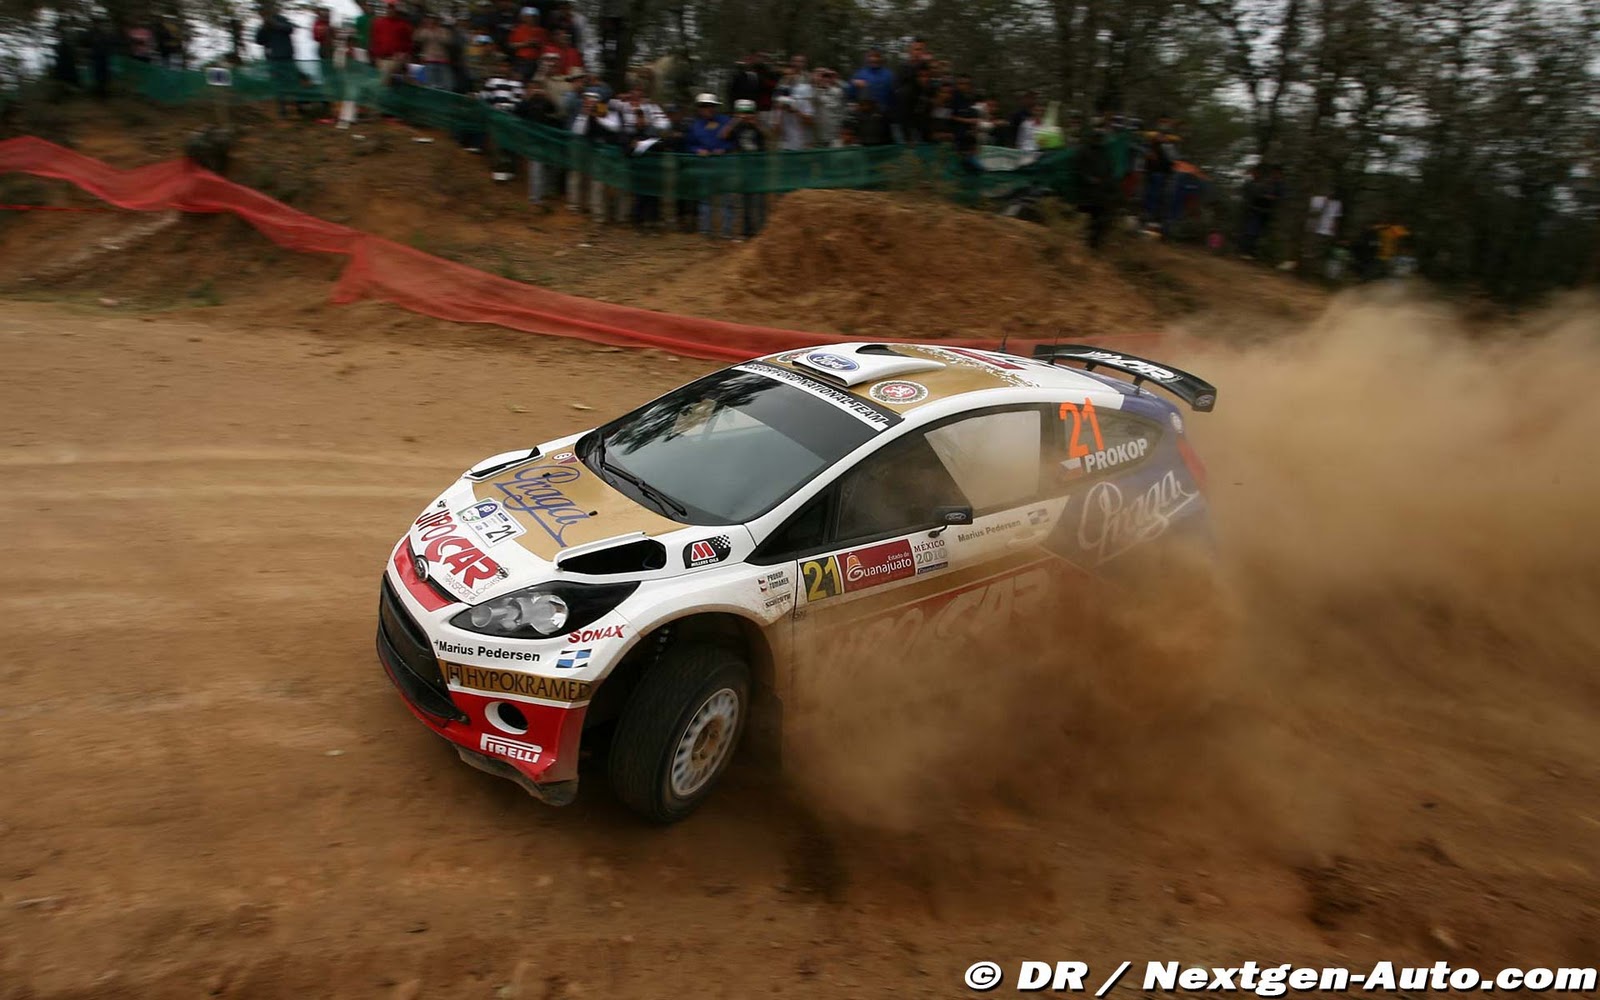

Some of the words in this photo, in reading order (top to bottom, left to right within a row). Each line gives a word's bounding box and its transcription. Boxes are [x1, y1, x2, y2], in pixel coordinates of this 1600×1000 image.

[810, 353, 853, 371] Ford
[851, 397, 888, 424] TEAM
[1059, 397, 1104, 458] 21
[1084, 438, 1148, 473] PROKOP
[493, 465, 590, 547] Praga
[1078, 470, 1199, 562] Praga
[485, 524, 517, 543] 21
[958, 530, 985, 543] Marius
[986, 519, 1021, 535] Pedersen
[887, 553, 903, 561] Estado
[914, 539, 945, 553] MÉXICO
[915, 548, 948, 564] 2010
[803, 556, 841, 601] 21
[847, 558, 912, 582] Guanajuato
[568, 624, 625, 643] SONAX
[439, 640, 474, 656] Marius
[478, 646, 541, 662] Pedersen
[467, 668, 591, 700] HYPOKRAMED
[480, 733, 543, 763] PIRELLI
